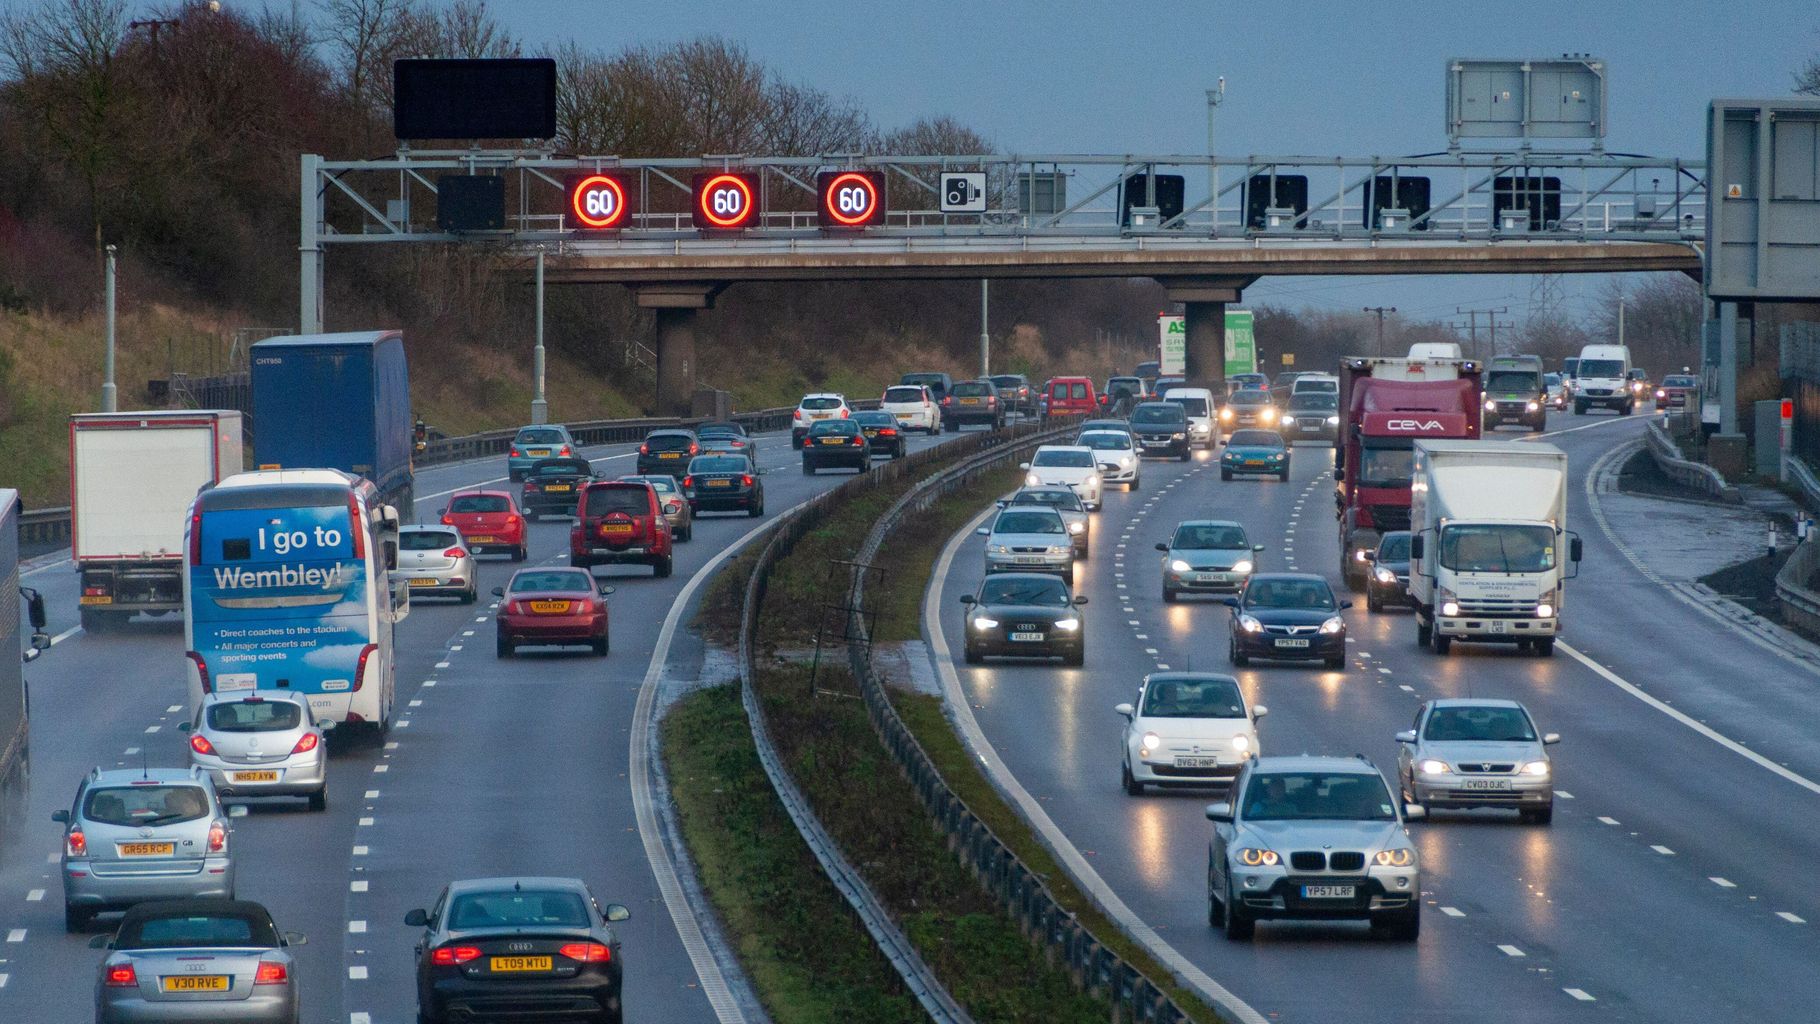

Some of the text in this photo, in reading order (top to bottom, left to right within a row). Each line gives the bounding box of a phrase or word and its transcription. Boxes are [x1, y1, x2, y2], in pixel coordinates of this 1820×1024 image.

[586, 189, 613, 215] 60
[714, 189, 740, 214] 60
[839, 187, 866, 212] 60
[1388, 420, 1444, 430] CEVA
[258, 526, 342, 554] I go to
[214, 562, 342, 590] Wembley!
[220, 629, 246, 638] Direct
[248, 628, 284, 636] coaches
[297, 626, 310, 634] the
[313, 626, 347, 634] stadium
[221, 640, 317, 652] All major concerts and
[221, 652, 287, 663] sporting events
[1177, 758, 1214, 766] DV62 HNP
[236, 772, 256, 780] NH57
[1466, 780, 1505, 788] CV03 OJC
[124, 844, 169, 854] GR55 RCF
[1308, 887, 1352, 896] YP57 LRF
[496, 958, 548, 968] LT09 MTU
[174, 978, 219, 988] V30 RVE
